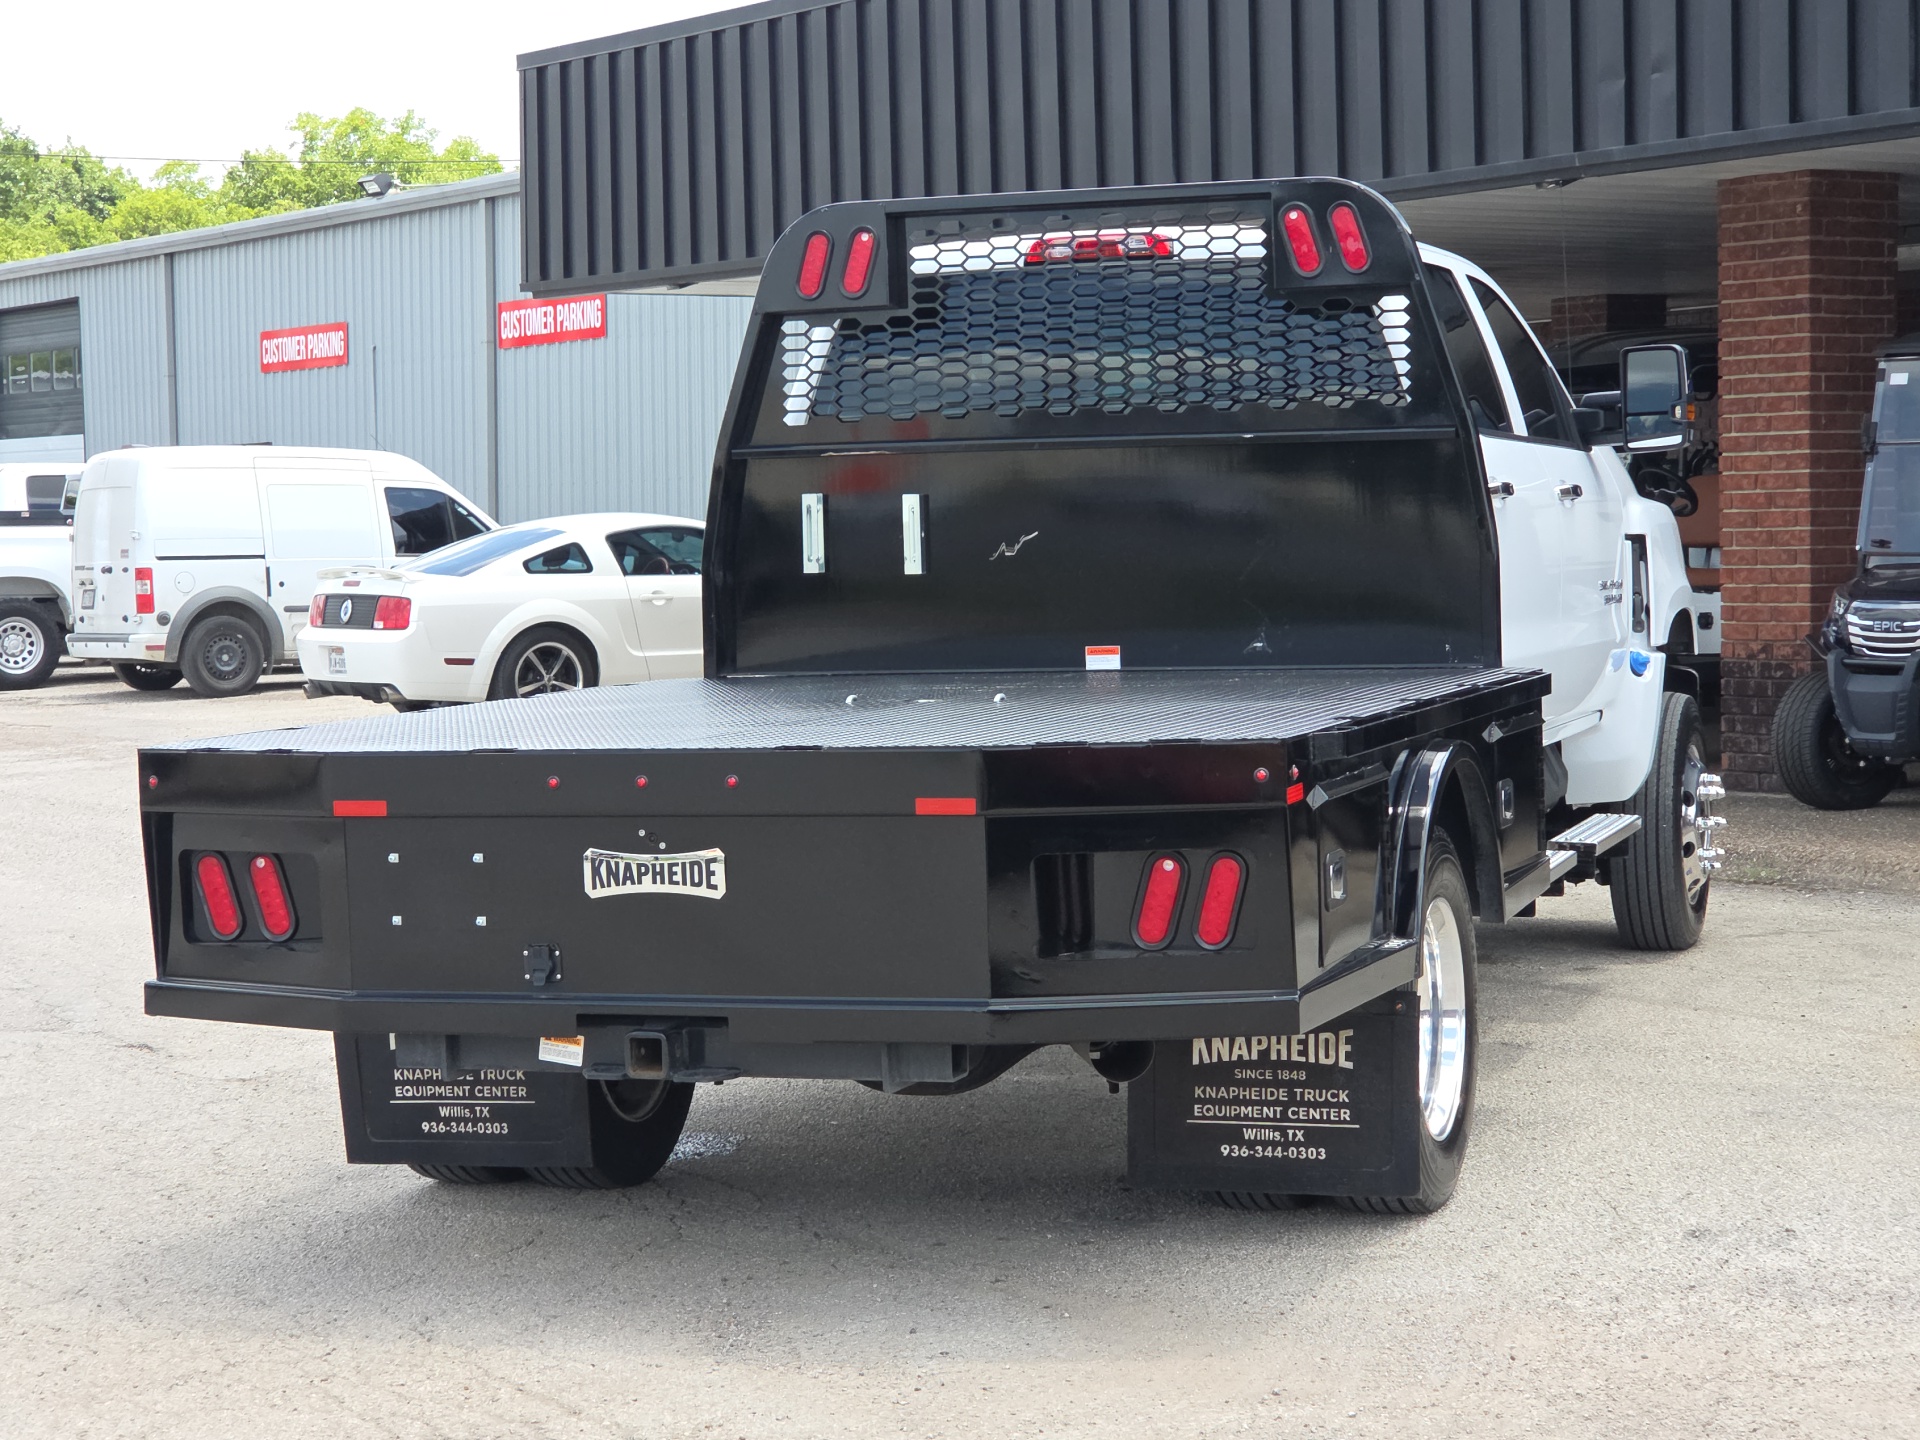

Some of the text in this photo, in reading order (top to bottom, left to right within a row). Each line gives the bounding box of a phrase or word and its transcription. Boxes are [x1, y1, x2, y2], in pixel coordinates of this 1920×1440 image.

[501, 299, 601, 339] CUSTOMER PARKING
[263, 331, 344, 364] CUSTOMER PARKING
[1874, 621, 1902, 631] EPIC
[590, 856, 718, 891] KNAPHEIDE
[1193, 1029, 1354, 1069] KNAPHEIDE
[393, 1068, 474, 1081] KNAPH
[1234, 1069, 1306, 1081] SINCE 1848
[394, 1085, 527, 1097] EQUIPMENT CENTER
[1194, 1086, 1350, 1103] KNAPHEIDE TRUCK
[439, 1106, 490, 1118] Willis, TX
[1194, 1104, 1351, 1121] EQUIPMENT CENTER
[421, 1122, 509, 1134] 936-344-0303
[1243, 1128, 1305, 1142] Willis, TX
[1220, 1144, 1326, 1160] 936-344-0303
